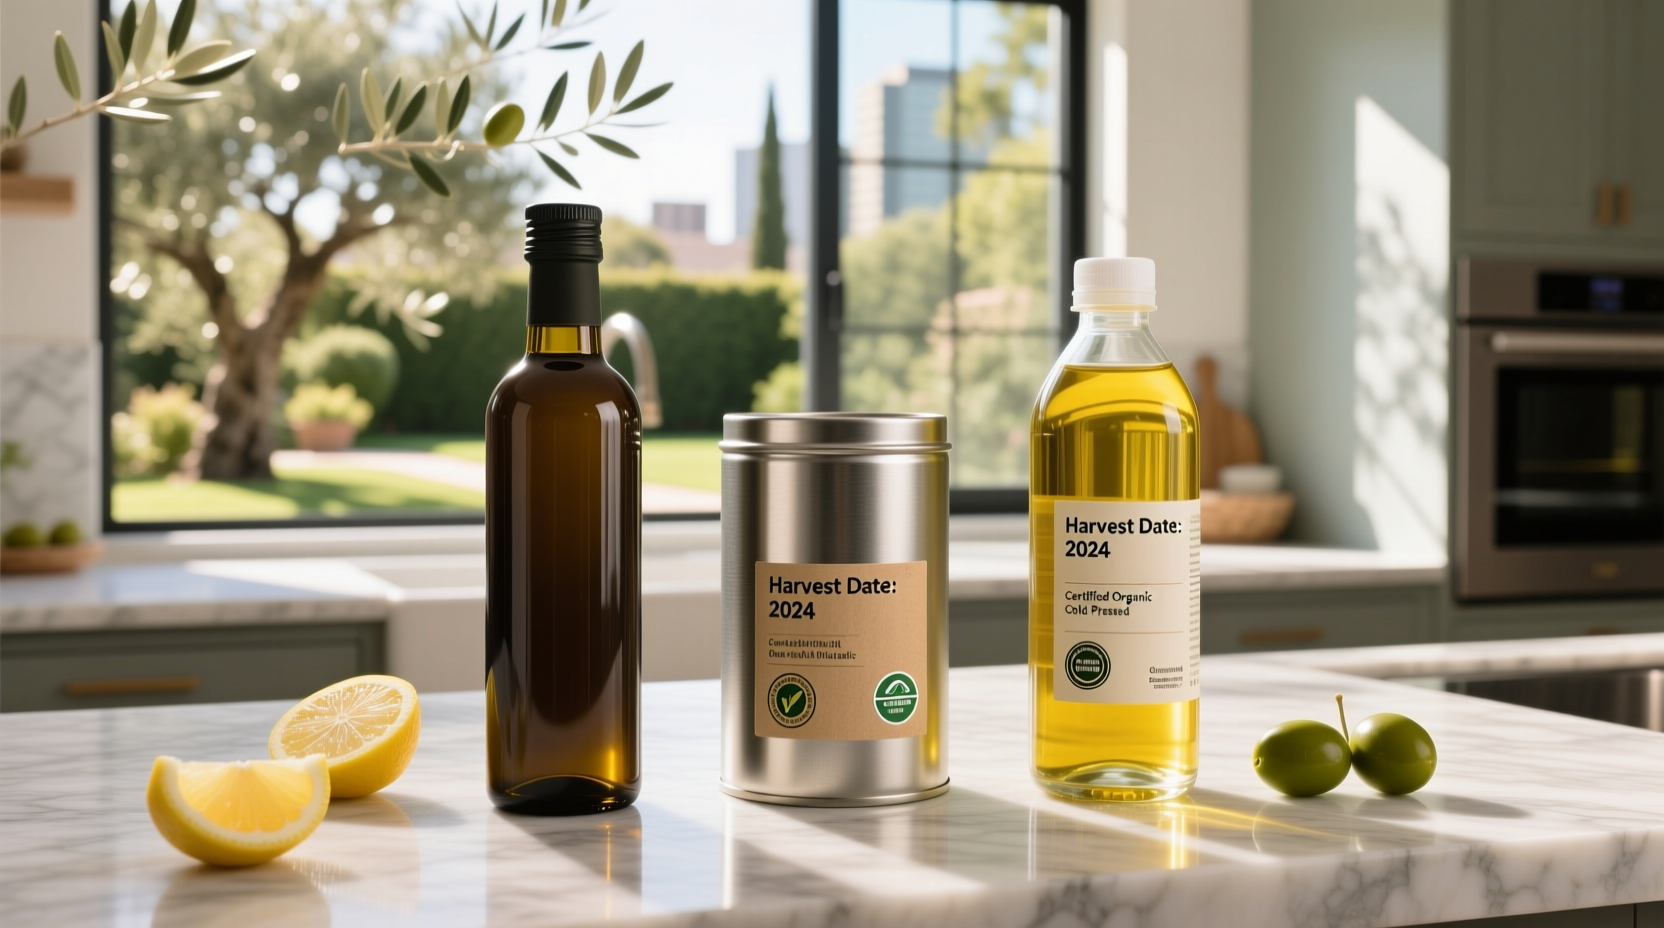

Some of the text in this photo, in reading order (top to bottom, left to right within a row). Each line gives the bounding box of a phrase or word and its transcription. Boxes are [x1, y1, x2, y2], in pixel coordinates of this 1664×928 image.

[1065, 516, 1183, 535] Harvest Date:
[1065, 539, 1111, 559] 2024
[769, 575, 897, 595] Harvest Date:
[1111, 590, 1153, 605] Organic
[768, 599, 816, 620] 2024
